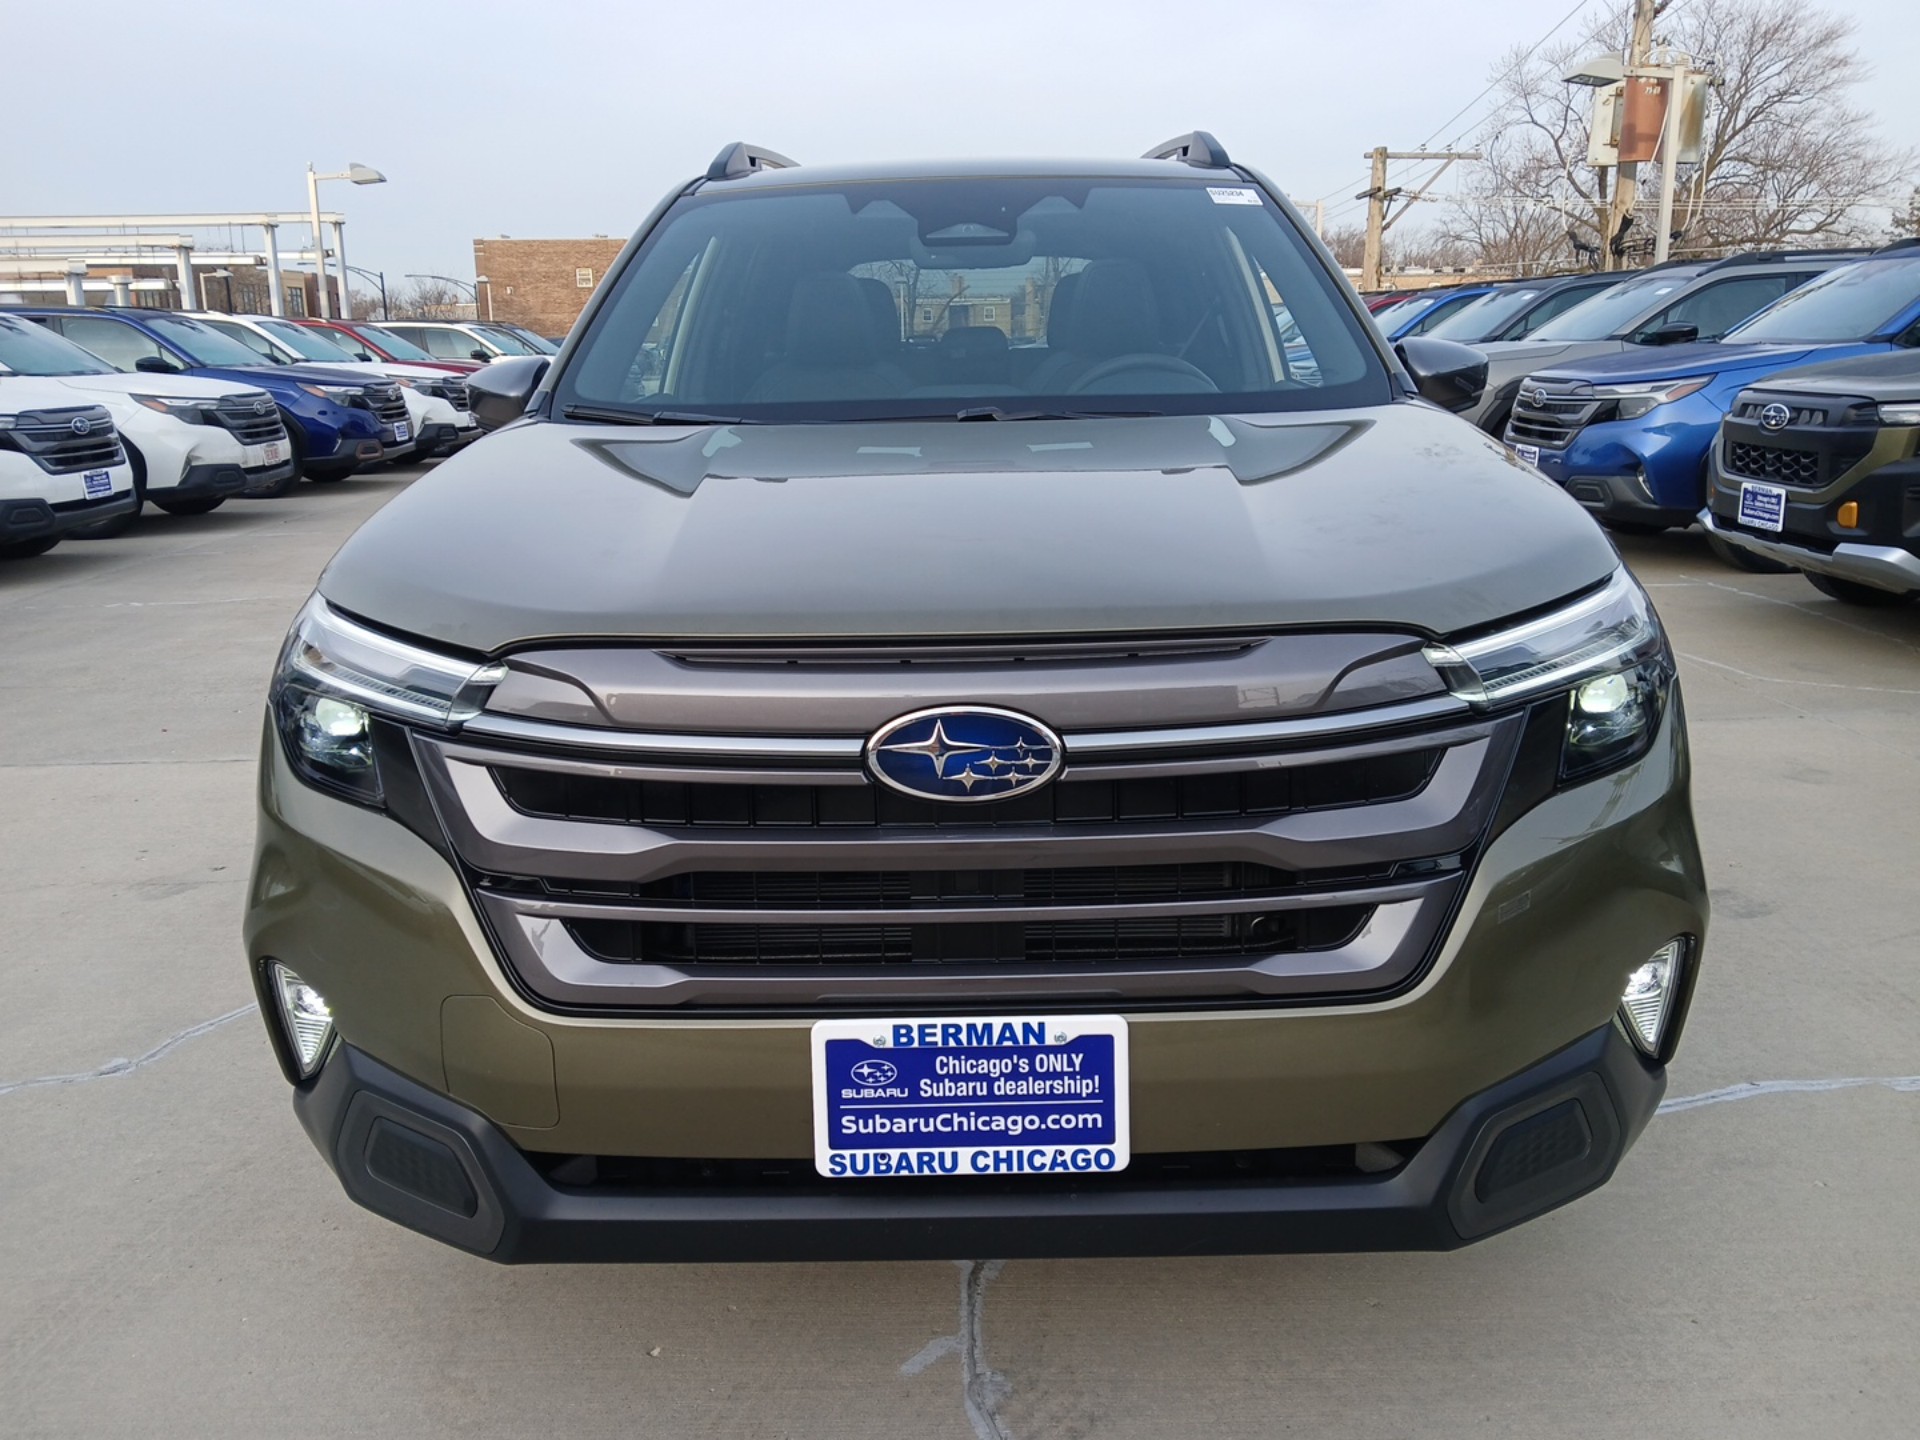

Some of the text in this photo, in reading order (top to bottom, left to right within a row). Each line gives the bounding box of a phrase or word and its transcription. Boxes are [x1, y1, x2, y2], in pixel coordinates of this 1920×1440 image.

[892, 1022, 1046, 1047] BERMAN
[935, 1053, 1084, 1077] Chicago's ONLY
[841, 1087, 908, 1099] SUBARU
[919, 1075, 1100, 1098] Subaru dealership!
[841, 1111, 1103, 1135] SubaruChicago.com
[828, 1148, 1116, 1176] SUBARU CHICAGO
